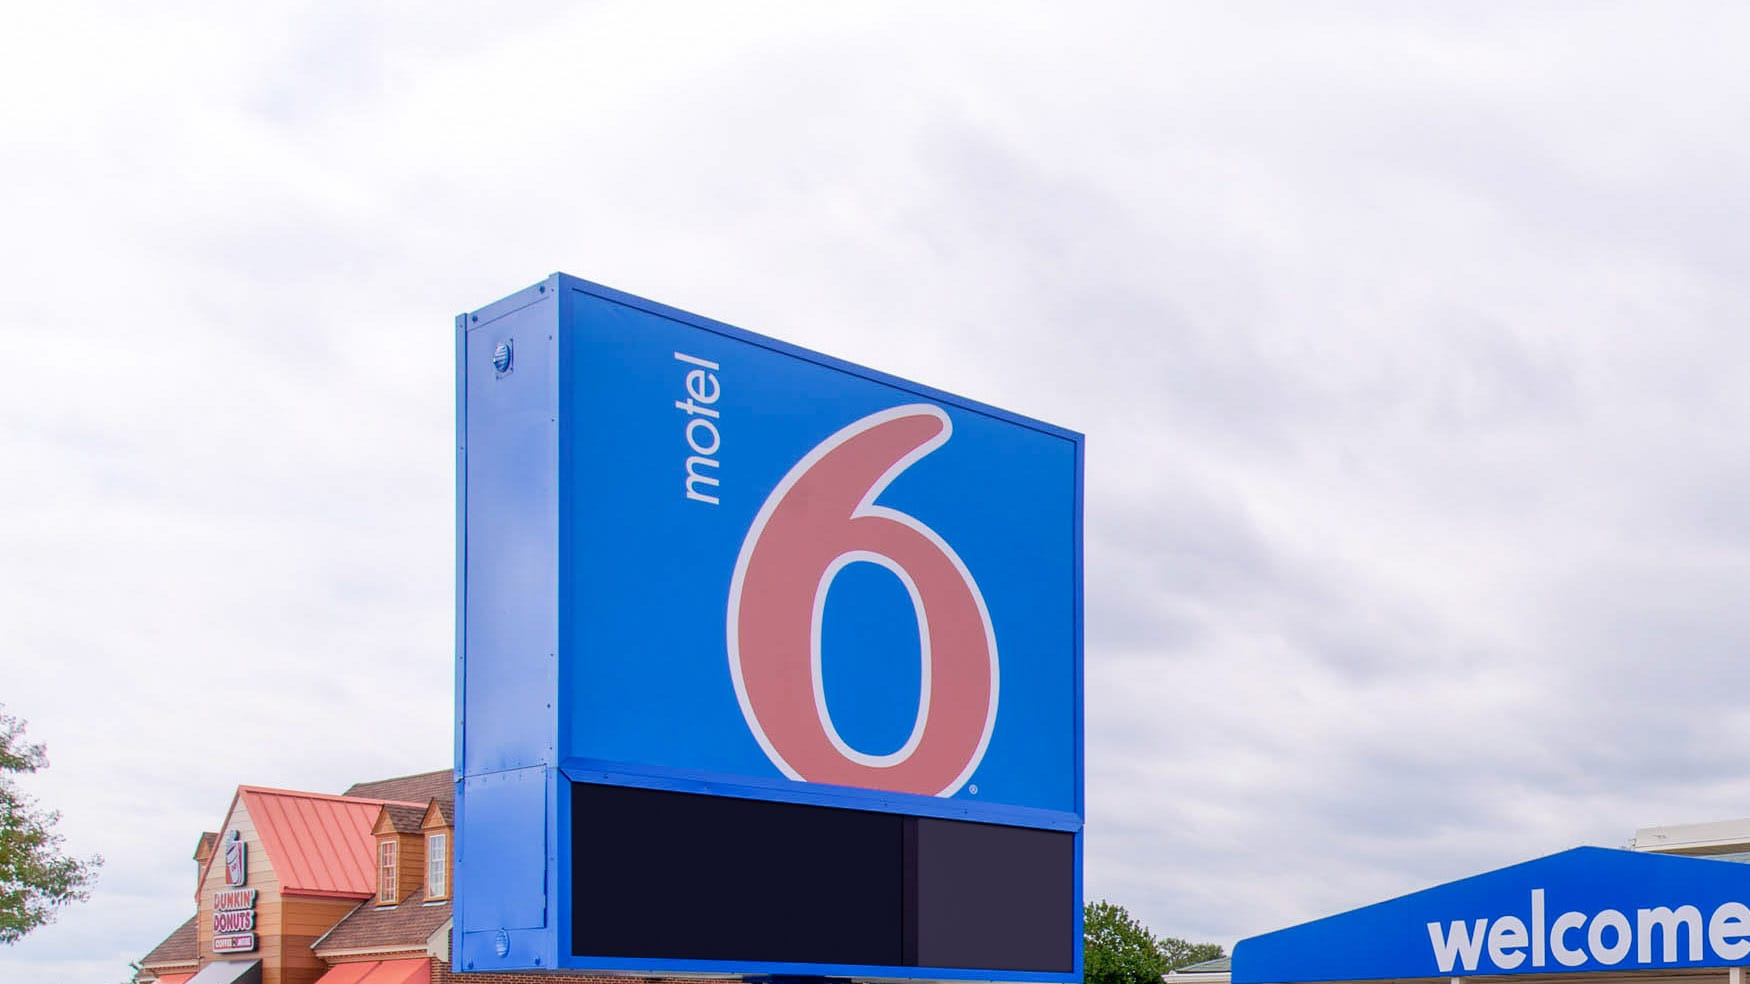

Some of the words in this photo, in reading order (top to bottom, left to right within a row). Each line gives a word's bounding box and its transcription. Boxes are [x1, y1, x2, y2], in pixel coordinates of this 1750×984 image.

[674, 351, 721, 505] motel
[727, 403, 1000, 799] 6
[213, 890, 254, 910] DUNKIN'
[213, 911, 251, 932] DONUTS
